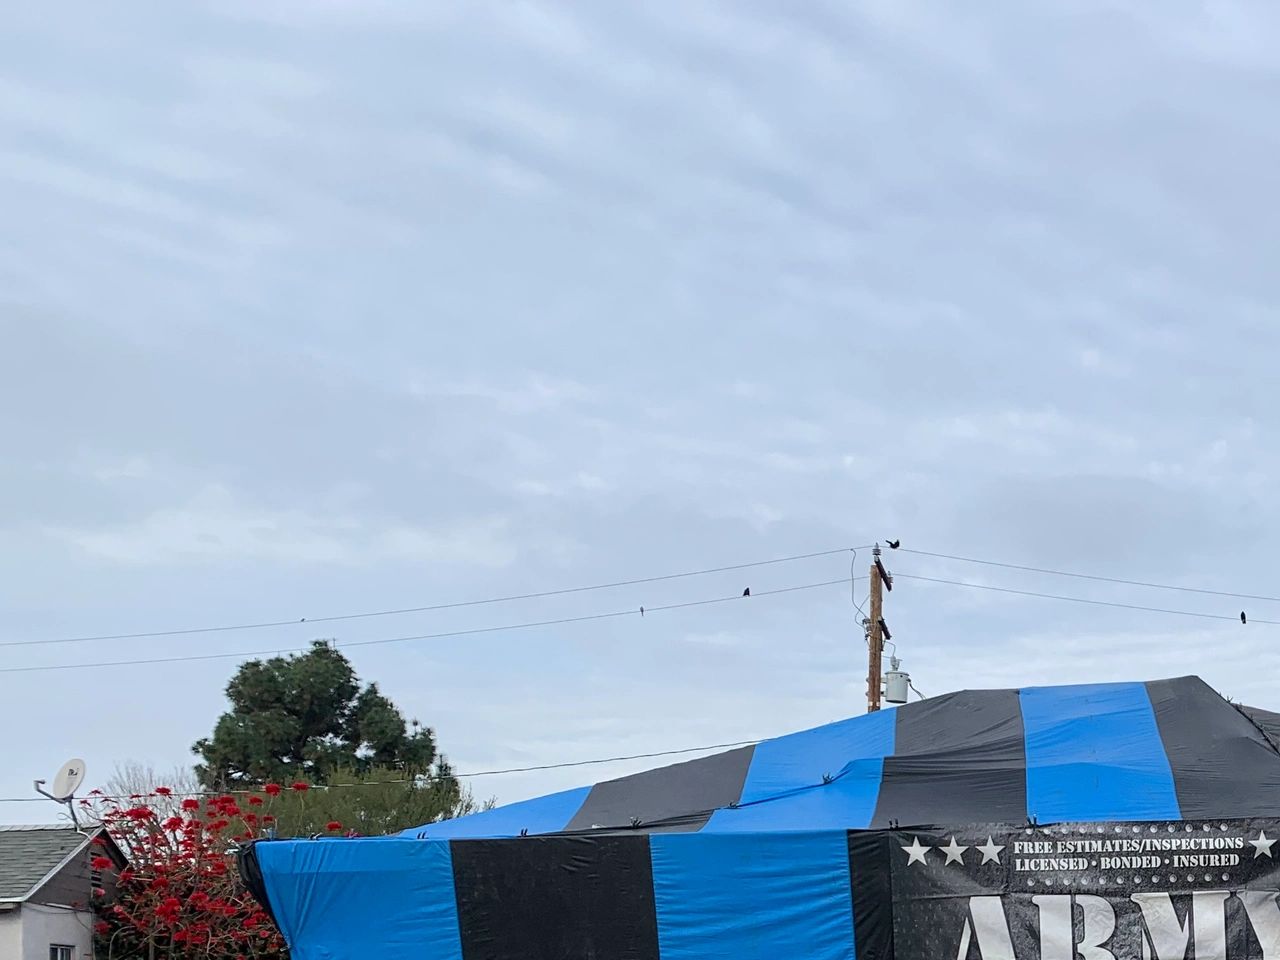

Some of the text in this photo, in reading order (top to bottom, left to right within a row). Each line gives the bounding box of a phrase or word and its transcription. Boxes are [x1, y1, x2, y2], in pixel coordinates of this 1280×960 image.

[1014, 837, 1244, 854] FREE ESTIMATES/INSPECTIONS
[1015, 853, 1240, 871] LICENSED BONDED INSURED
